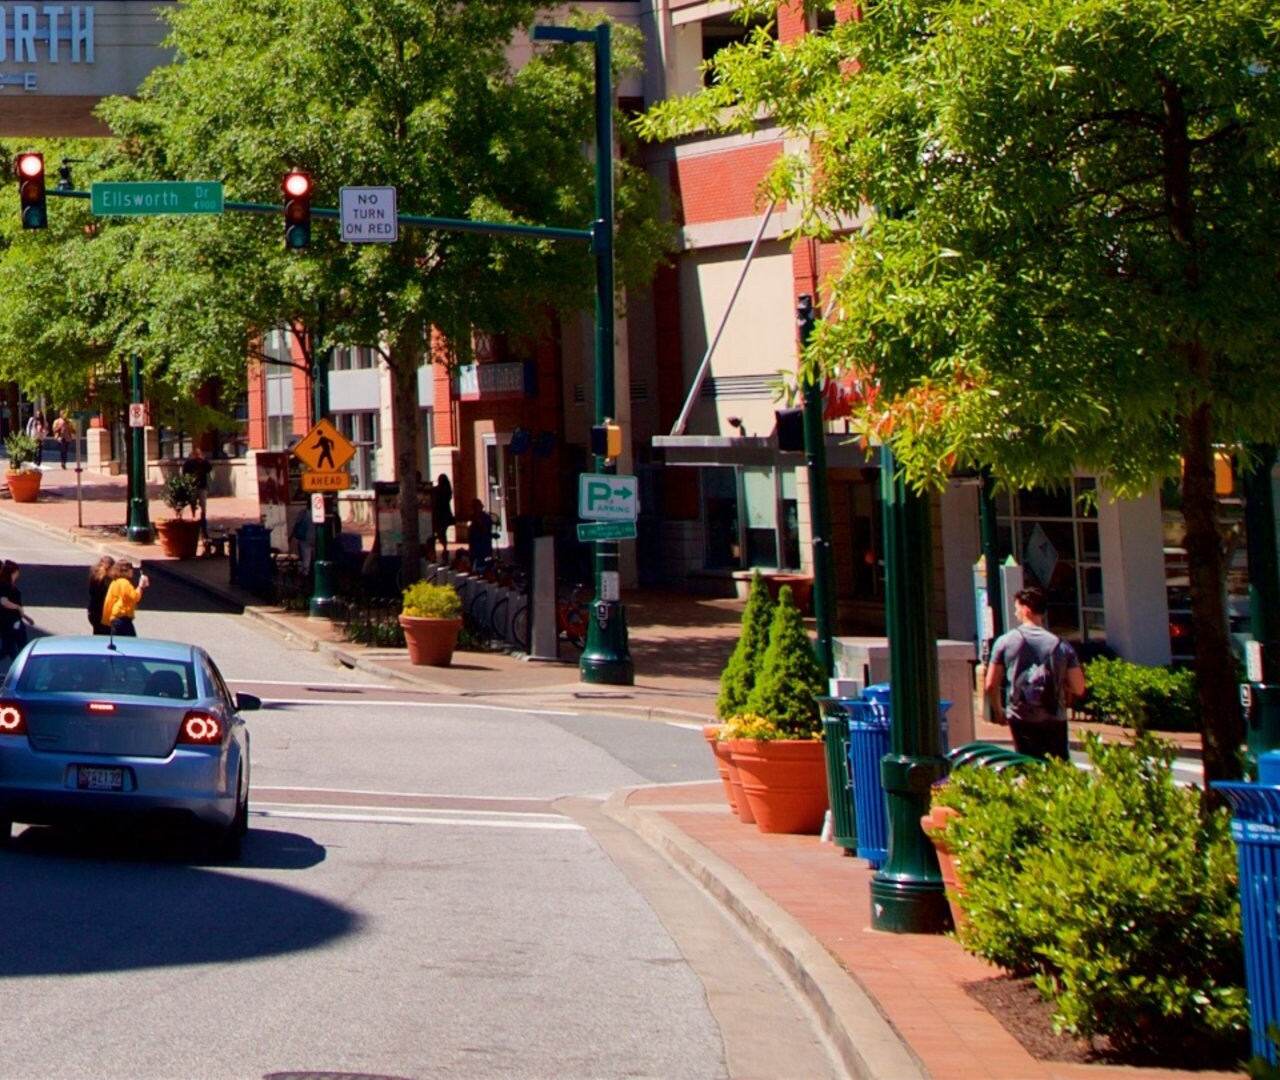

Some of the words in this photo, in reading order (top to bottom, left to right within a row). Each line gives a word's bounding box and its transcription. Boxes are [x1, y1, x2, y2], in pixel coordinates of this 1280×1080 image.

[103, 190, 178, 207] Ellsworth
[195, 186, 209, 198] Dr
[358, 194, 378, 205] NO
[353, 209, 385, 219] TURN
[346, 223, 362, 234] ON
[368, 223, 392, 234] RED
[311, 476, 342, 486] AHEAD
